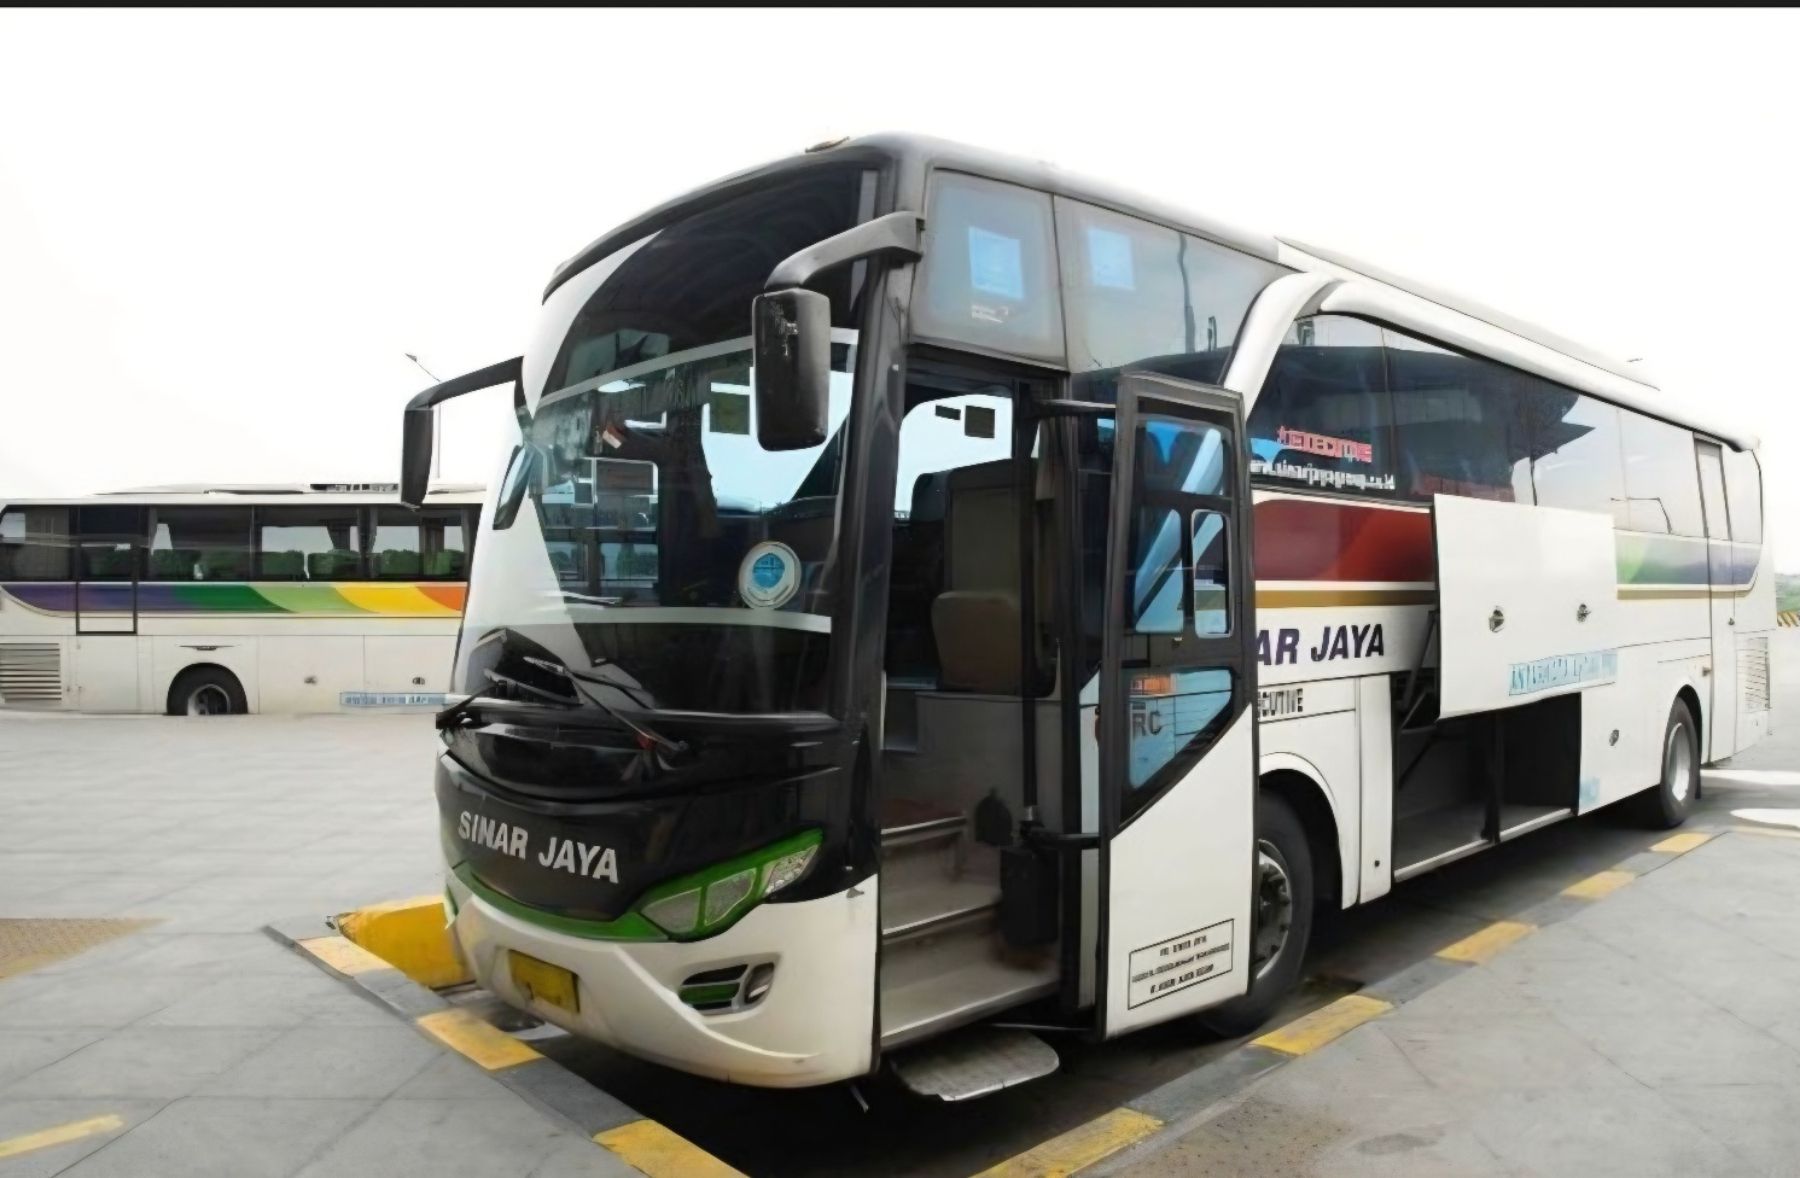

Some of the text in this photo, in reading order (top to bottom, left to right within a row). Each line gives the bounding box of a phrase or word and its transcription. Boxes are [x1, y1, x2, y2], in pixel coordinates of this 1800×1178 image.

[1310, 623, 1384, 662] JAYA
[458, 810, 619, 884] SINAR JAYA
